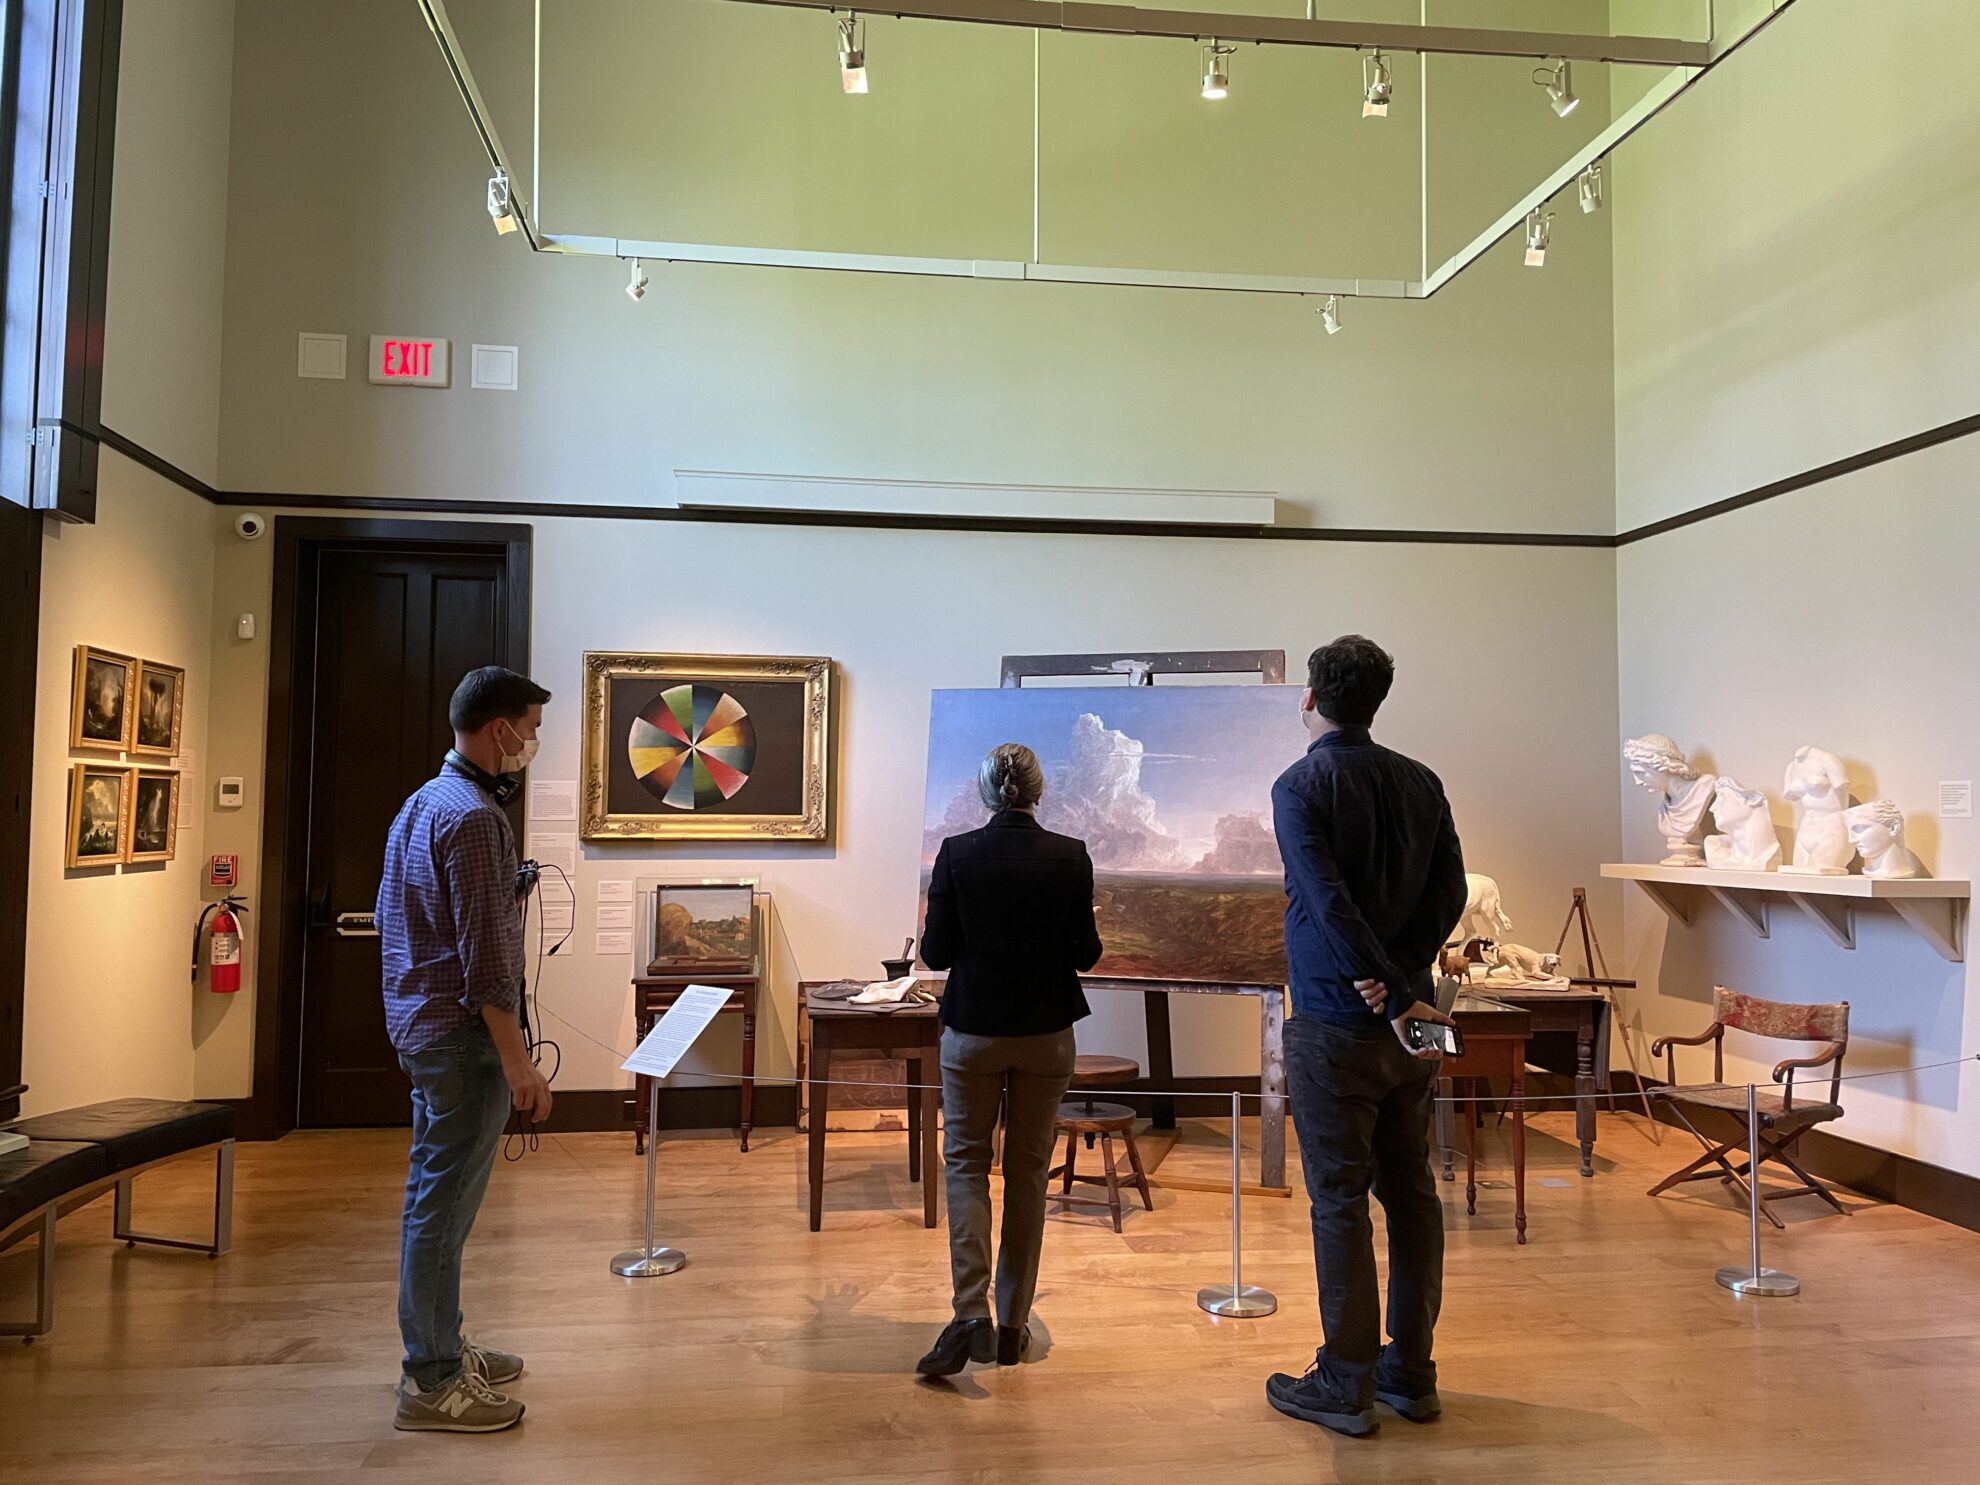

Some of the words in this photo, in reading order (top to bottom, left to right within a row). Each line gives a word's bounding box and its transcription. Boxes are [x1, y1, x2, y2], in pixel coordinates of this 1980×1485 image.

[383, 340, 433, 377] EXIT
[213, 856, 232, 864] FIRE
[438, 1391, 474, 1418] N
